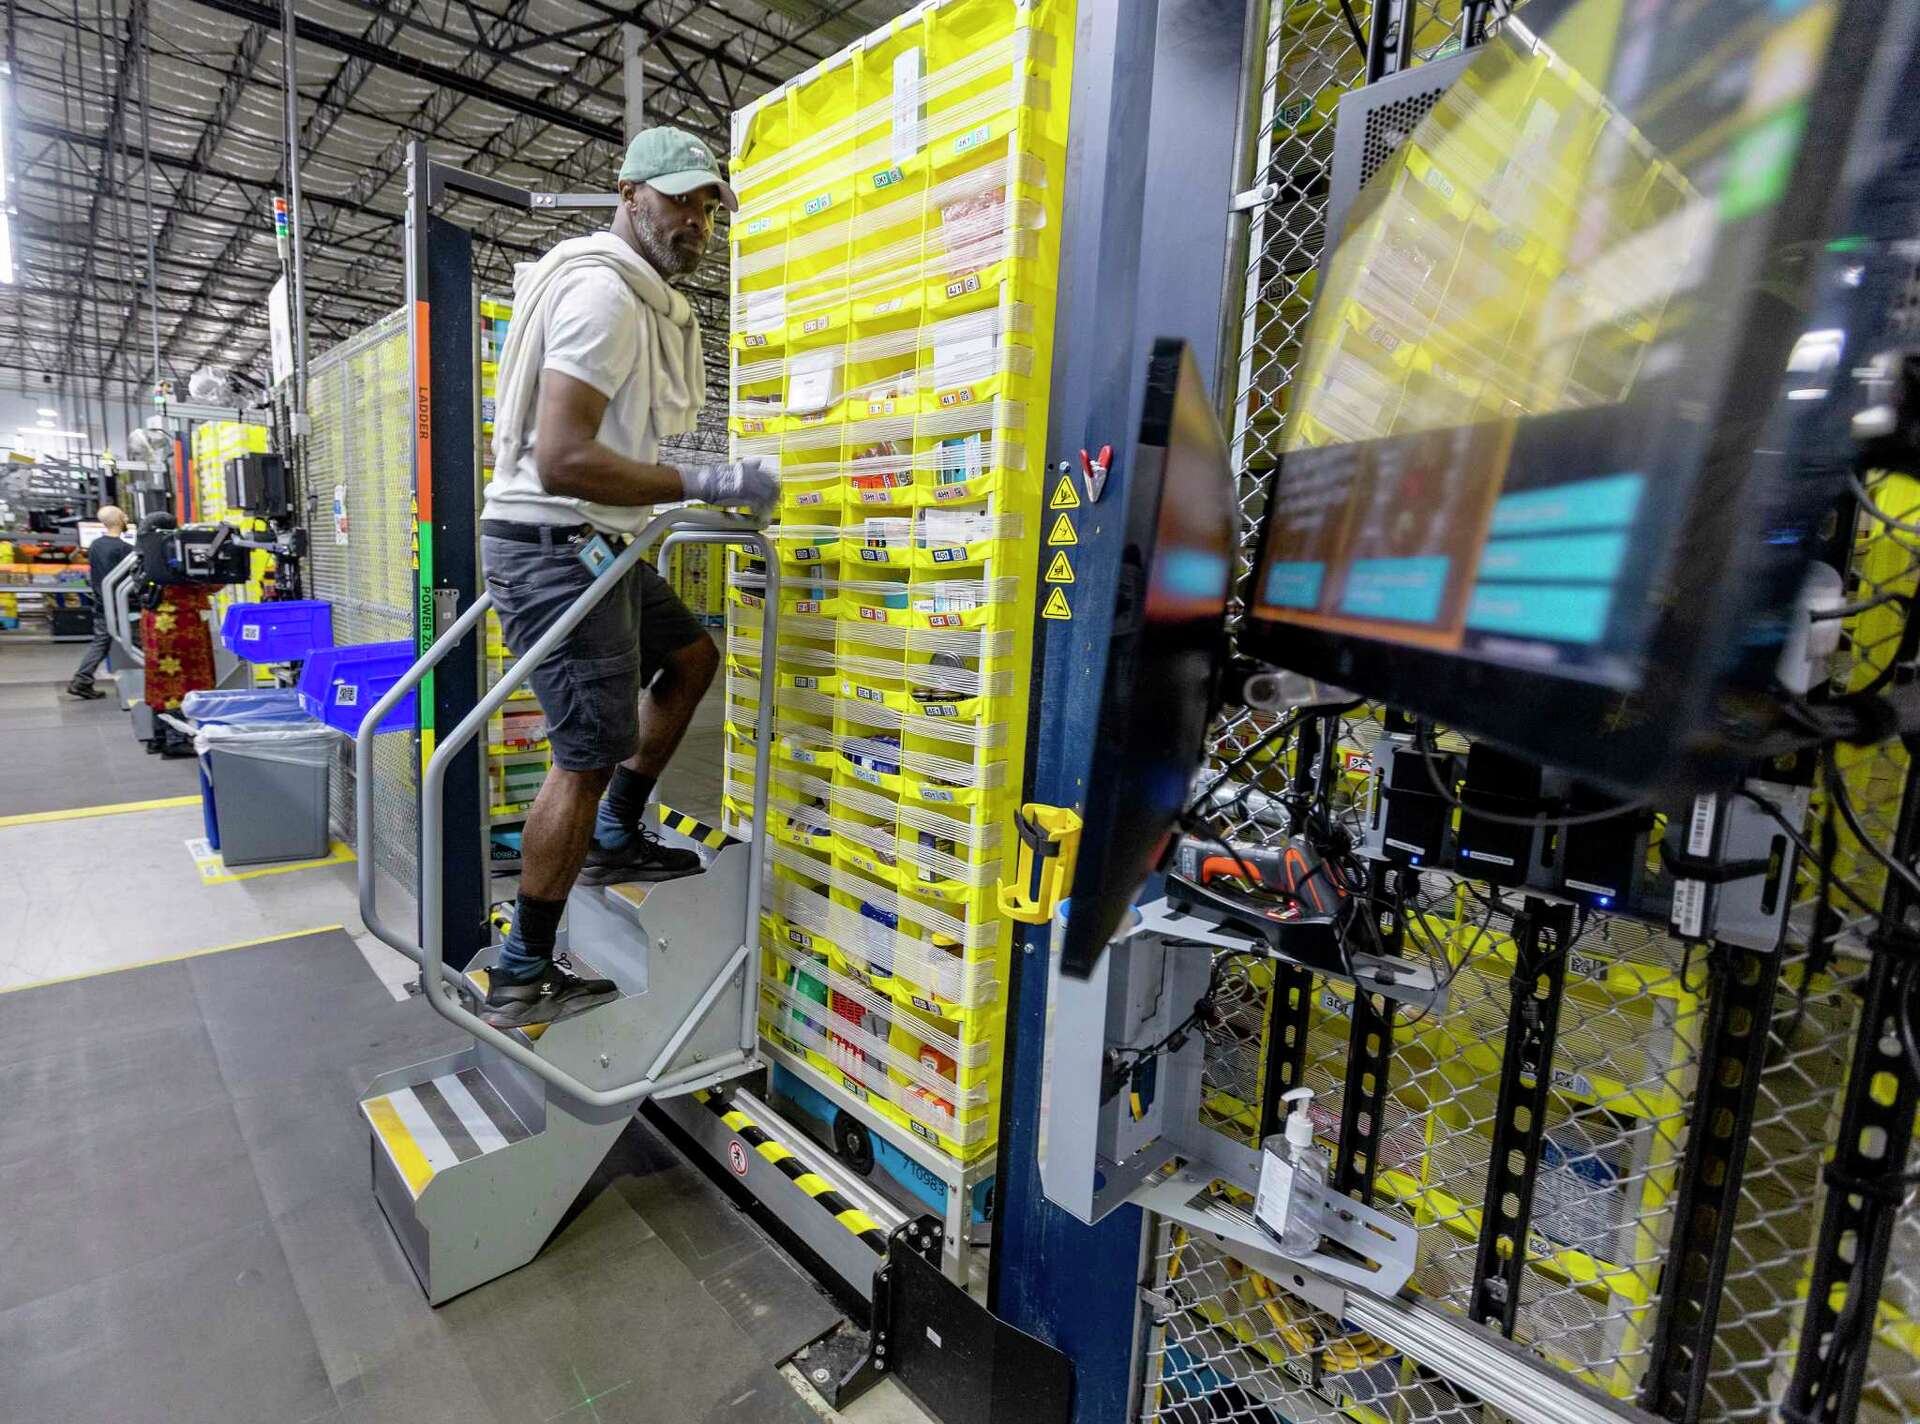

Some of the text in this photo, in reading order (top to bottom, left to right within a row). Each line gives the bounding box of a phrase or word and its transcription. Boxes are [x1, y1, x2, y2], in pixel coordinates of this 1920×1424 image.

[418, 386, 429, 440] LADDER
[422, 586, 432, 655] POWER ZO
